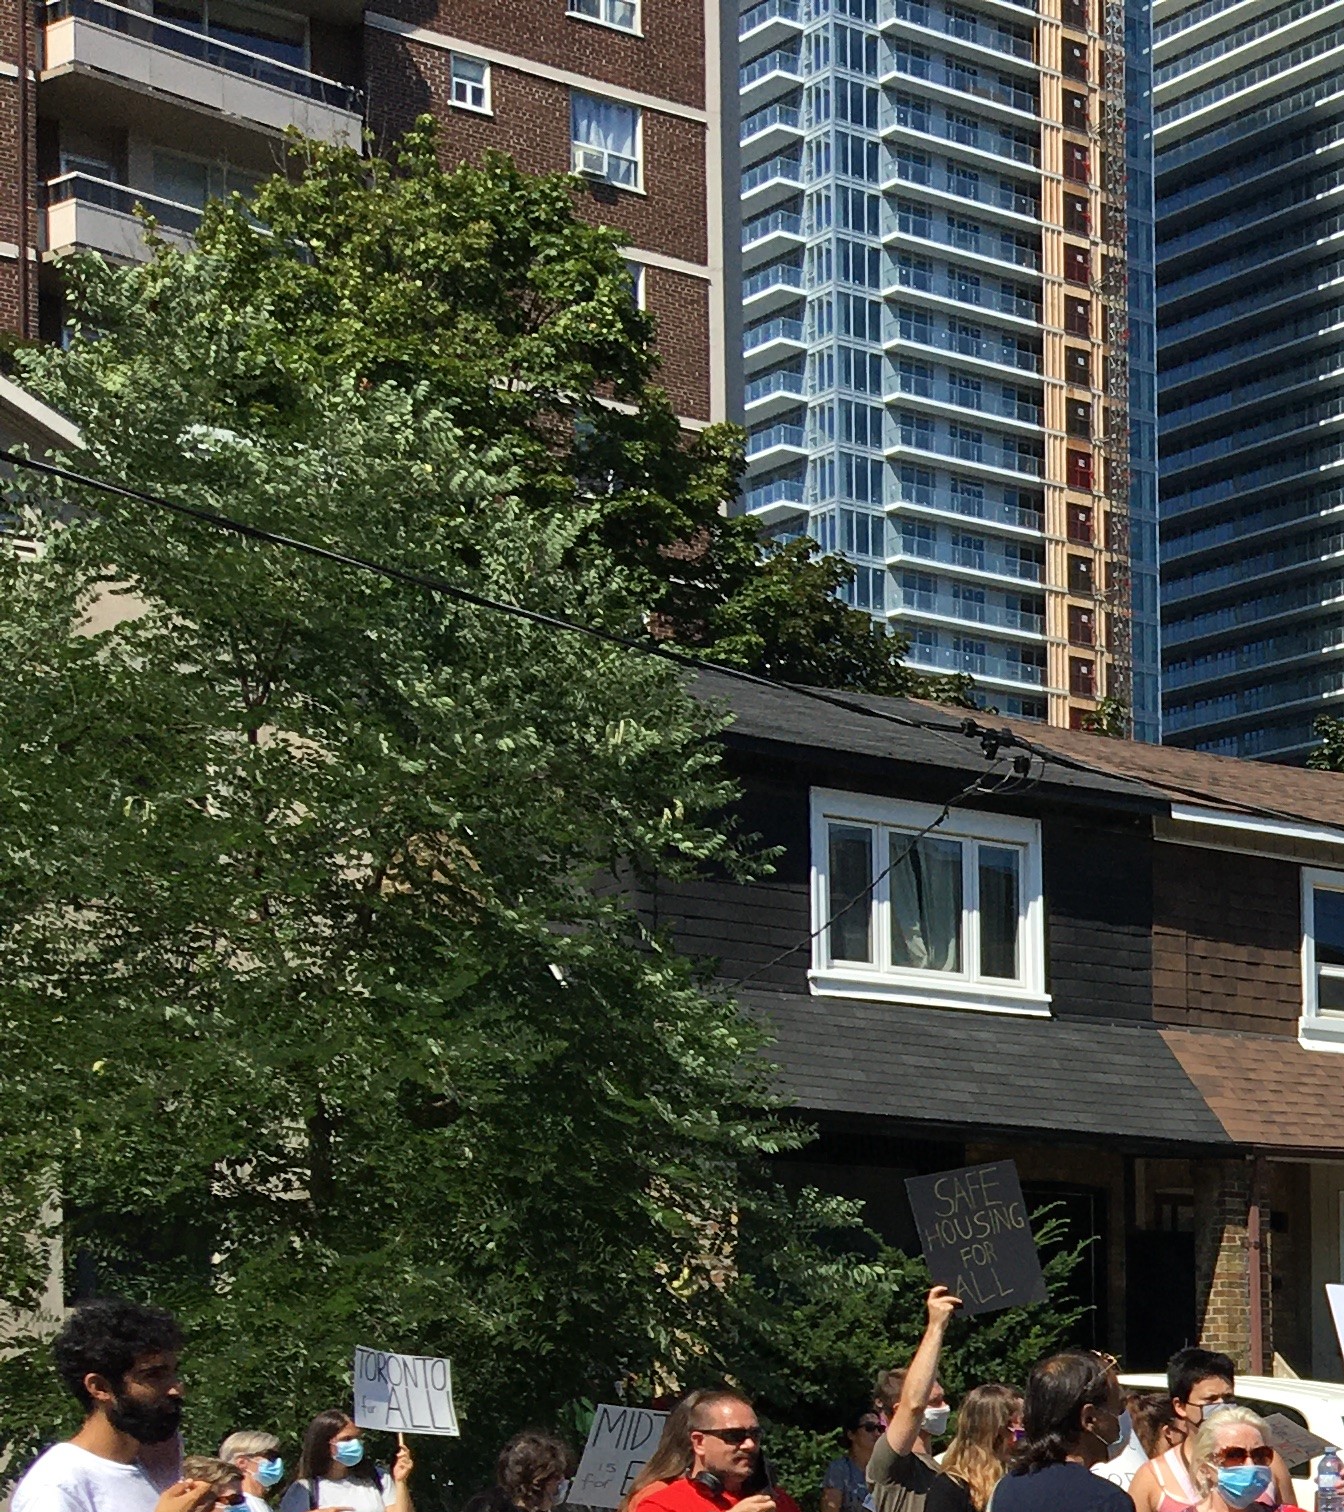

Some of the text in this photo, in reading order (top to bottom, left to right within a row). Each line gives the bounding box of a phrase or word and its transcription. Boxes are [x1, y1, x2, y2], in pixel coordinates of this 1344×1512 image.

[934, 1167, 1003, 1217] SAFE
[924, 1202, 1025, 1252] HOUSING
[960, 1241, 998, 1269] FOR
[956, 1268, 1015, 1305] ALL
[357, 1348, 447, 1391] TORONTO
[361, 1386, 457, 1432] for ALL!
[582, 1473, 613, 1490] for
